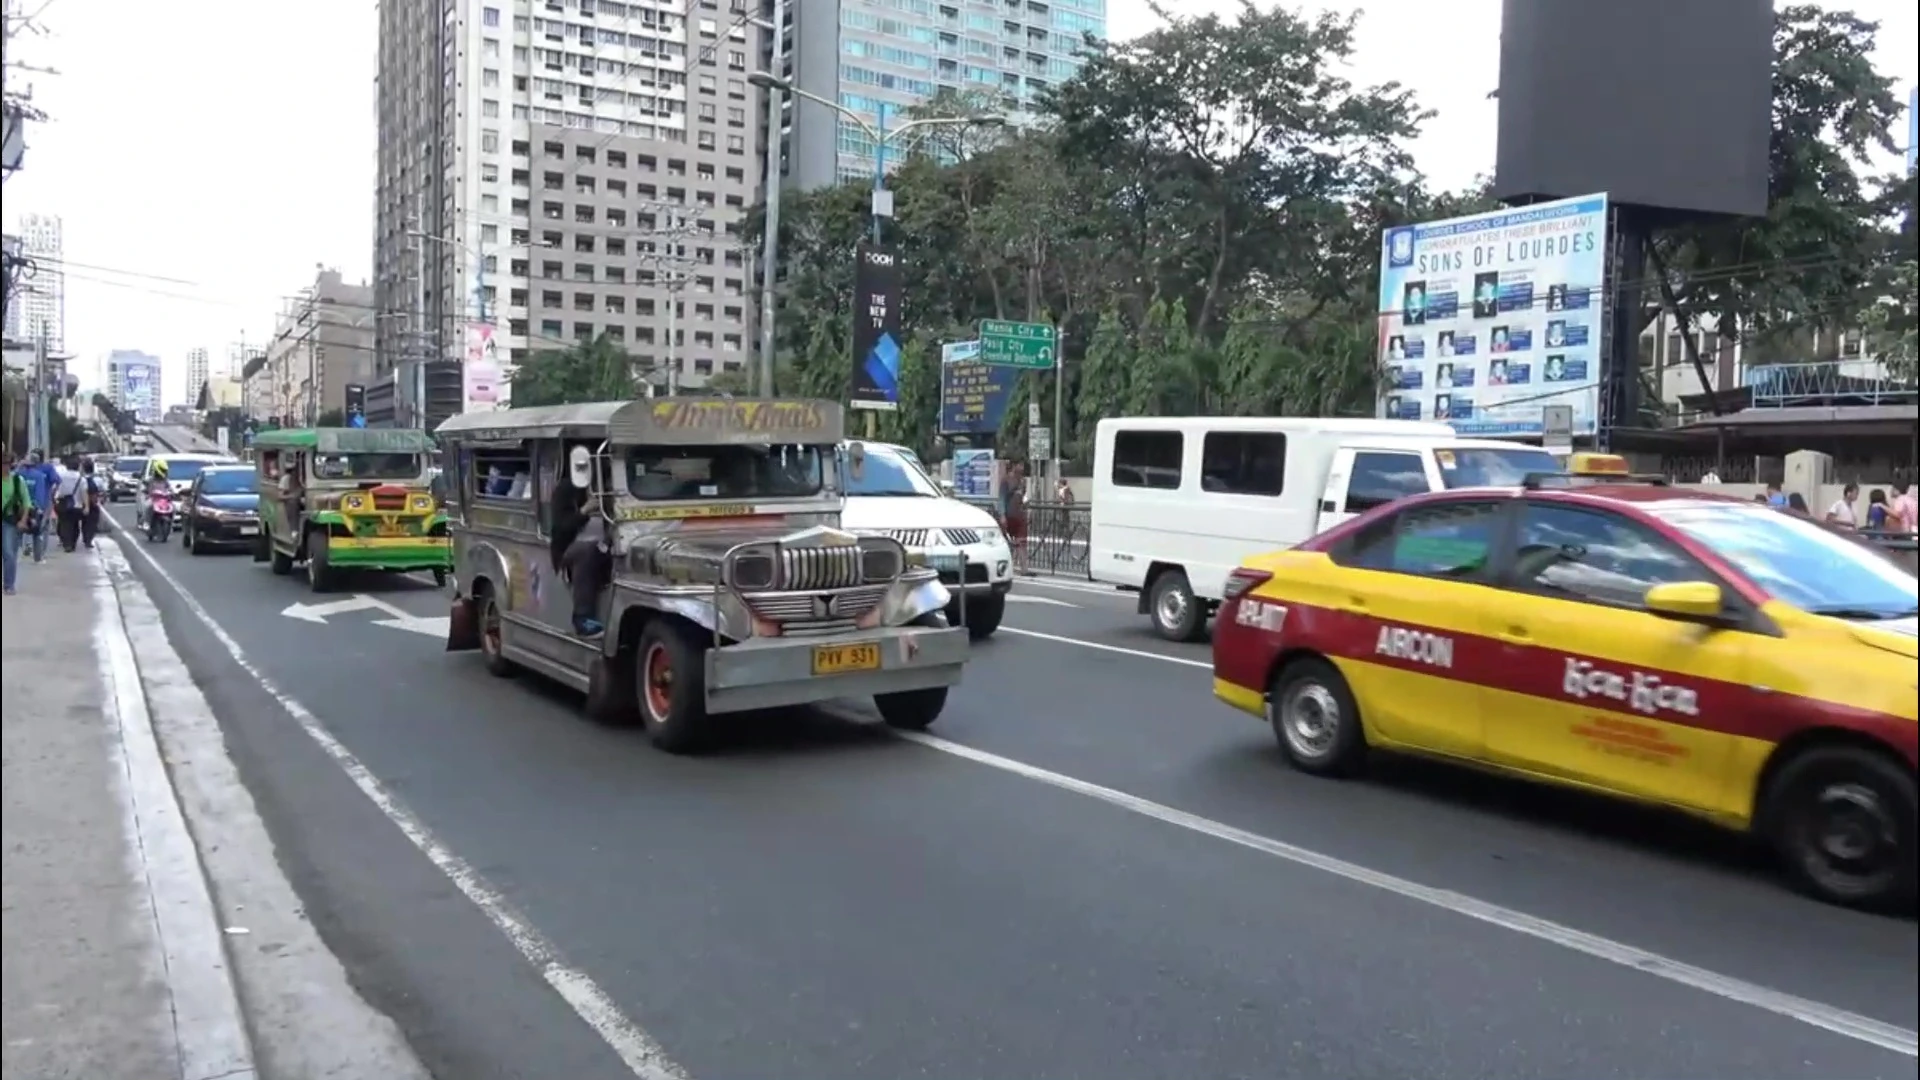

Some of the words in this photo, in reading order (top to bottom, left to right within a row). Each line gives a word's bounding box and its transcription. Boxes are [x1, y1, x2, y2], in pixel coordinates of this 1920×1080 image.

[1418, 225, 1454, 240] LOURDES
[1456, 220, 1489, 234] SCHOOL
[1492, 217, 1505, 228] OF
[1419, 230, 1500, 250] CONGRATULATES
[1503, 225, 1537, 241] THESE
[1538, 215, 1595, 233] BRILLIANT
[1419, 251, 1463, 275] SONS
[1474, 245, 1496, 267] OF
[1507, 231, 1595, 263] LOURDES
[871, 293, 886, 306] THE
[869, 305, 887, 317] NEW
[872, 317, 883, 329] TV
[986, 322, 1013, 335] Manila
[1018, 324, 1034, 338] City
[983, 337, 1004, 354] Pasig
[1008, 339, 1025, 353] City
[1375, 625, 1453, 668] AIRCON
[850, 647, 875, 664] 931
